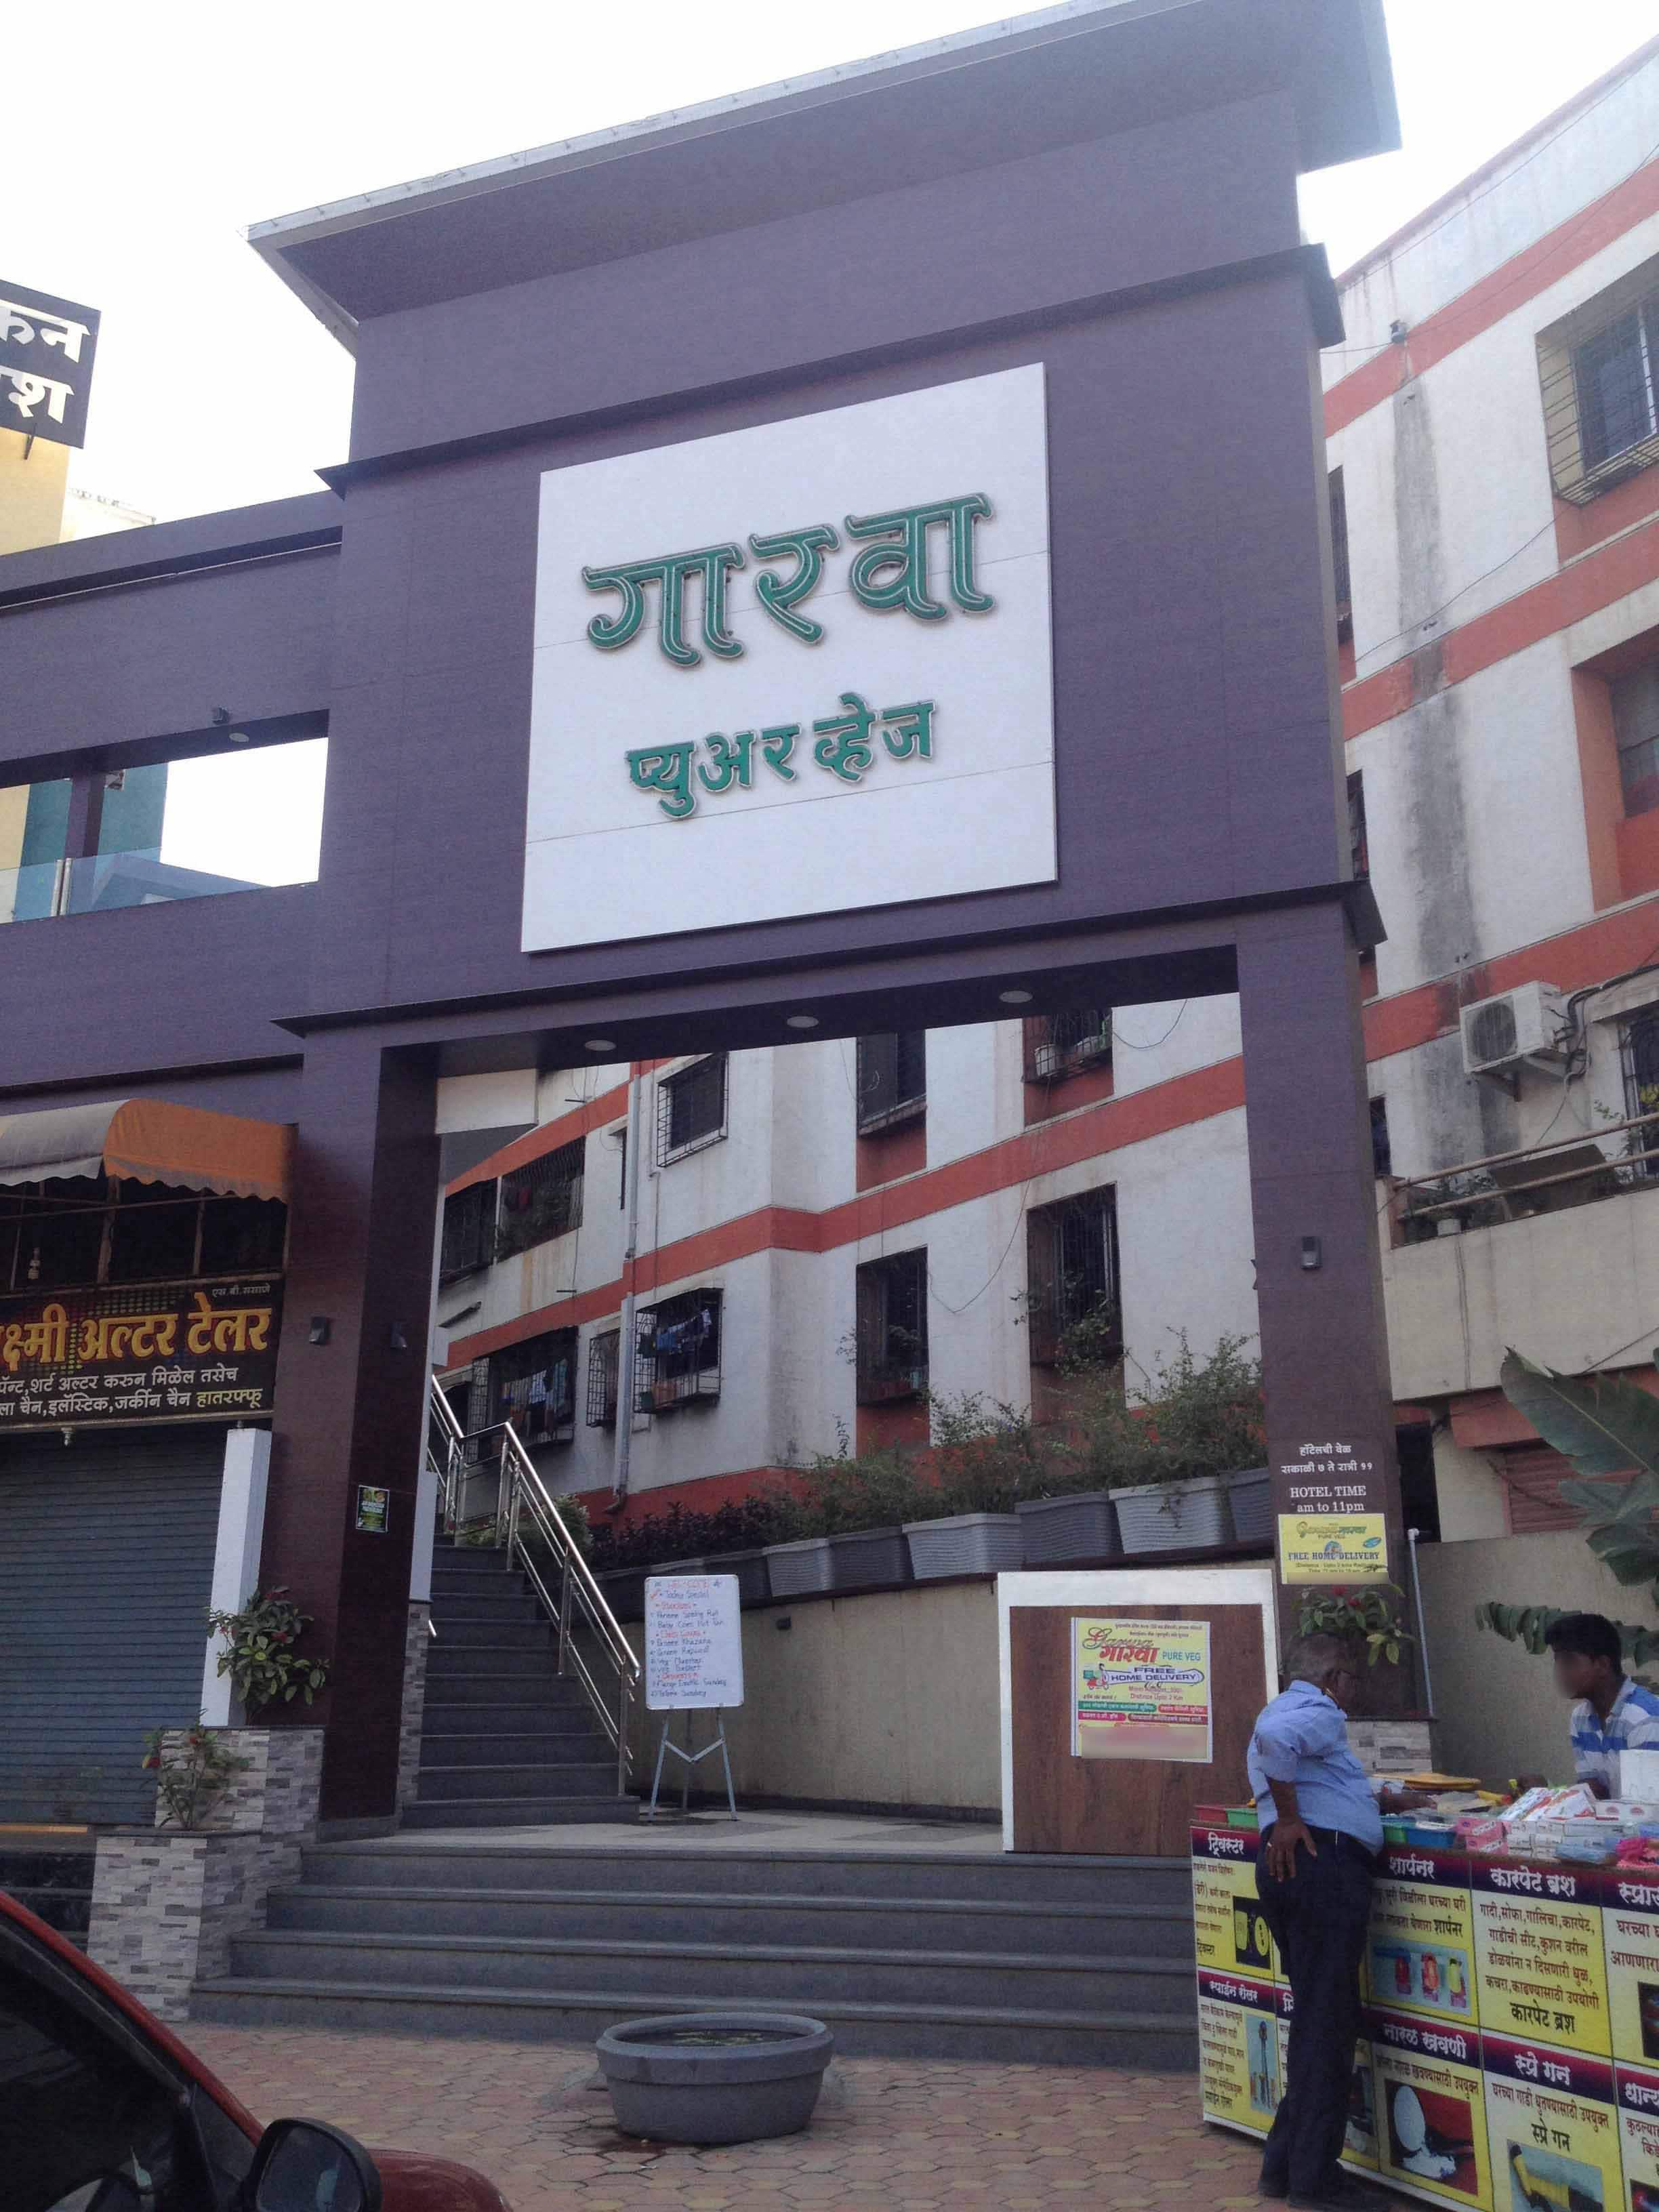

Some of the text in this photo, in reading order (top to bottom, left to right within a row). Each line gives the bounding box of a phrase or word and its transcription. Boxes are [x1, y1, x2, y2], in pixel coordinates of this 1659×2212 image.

[581, 492, 995, 668] गारवा
[0, 1291, 272, 1372] क्ष्मी अल्टर टेलर
[59, 1375, 99, 1391] अल्टर
[152, 1365, 195, 1386] मिळेल
[200, 1362, 239, 1383] तसेच
[167, 1387, 192, 1408] चैन
[1335, 1442, 1352, 1454] वेळ
[1280, 1461, 1315, 1474] सकाळी
[1327, 1460, 1335, 1472] ते
[1337, 1460, 1357, 1472] रात्री
[1290, 1485, 1367, 1498] HOTEL TIME
[1317, 1502, 1330, 1512] to
[1332, 1501, 1365, 1513] 11pm
[1288, 1551, 1380, 1561] FREE HOME DELIVERY
[1099, 1645, 1160, 1664] गारवा
[1162, 1652, 1202, 1661] PURE VEG
[1389, 1853, 1435, 1879] शार्पनर
[1490, 1865, 1576, 1898] कारपेट ब्रश
[1433, 1915, 1463, 1938] शार्पनर
[1488, 1928, 1518, 1946] गाडीची
[1564, 1938, 1589, 1957] वरील
[1534, 1955, 1571, 1979] दिसणारी
[1565, 1989, 1600, 2010] उपयोगी
[1509, 1999, 1576, 2036] कारपेट ब्रश
[1514, 2051, 1571, 2086] स्प्रे गन
[1579, 2106, 1610, 2133] उपयुक्त
[1531, 2116, 1571, 2152] स्प्रे गन
